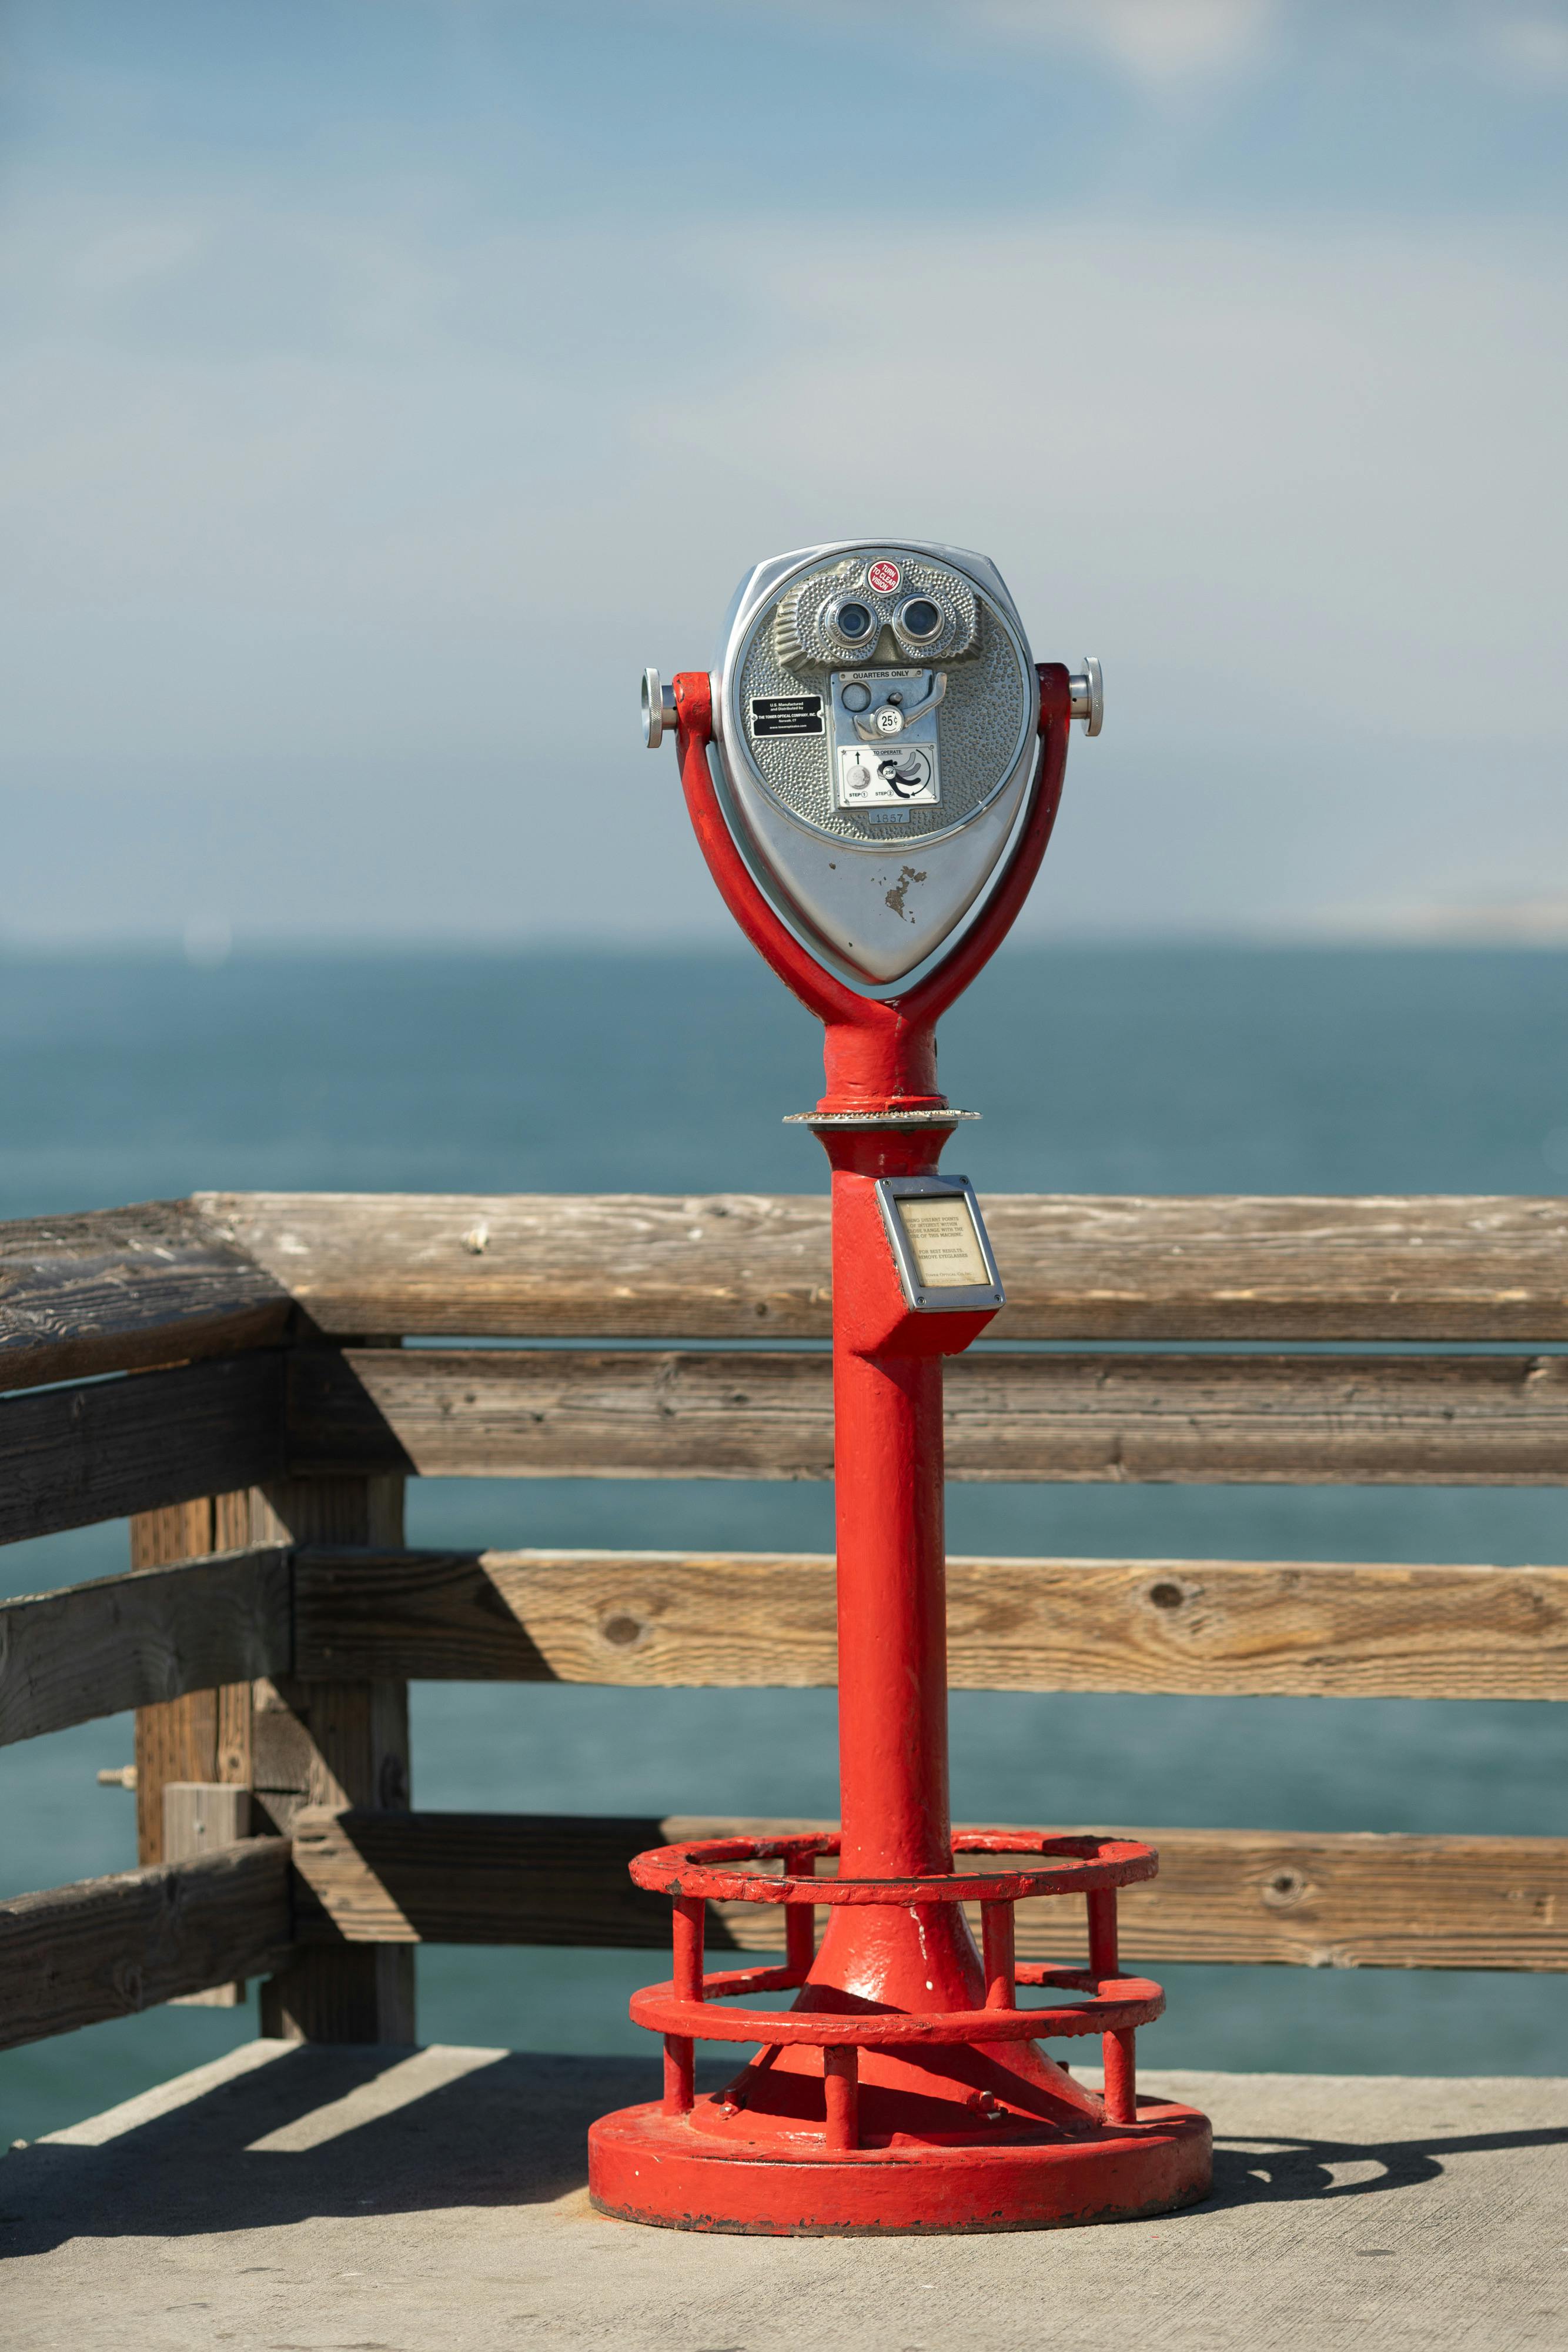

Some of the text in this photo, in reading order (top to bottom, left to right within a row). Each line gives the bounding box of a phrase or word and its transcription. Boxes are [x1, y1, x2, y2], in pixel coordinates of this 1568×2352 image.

[872, 567, 896, 587] TO CLEAR
[882, 564, 896, 577] TURN
[872, 576, 888, 590] VISION
[876, 814, 903, 823] 1857
